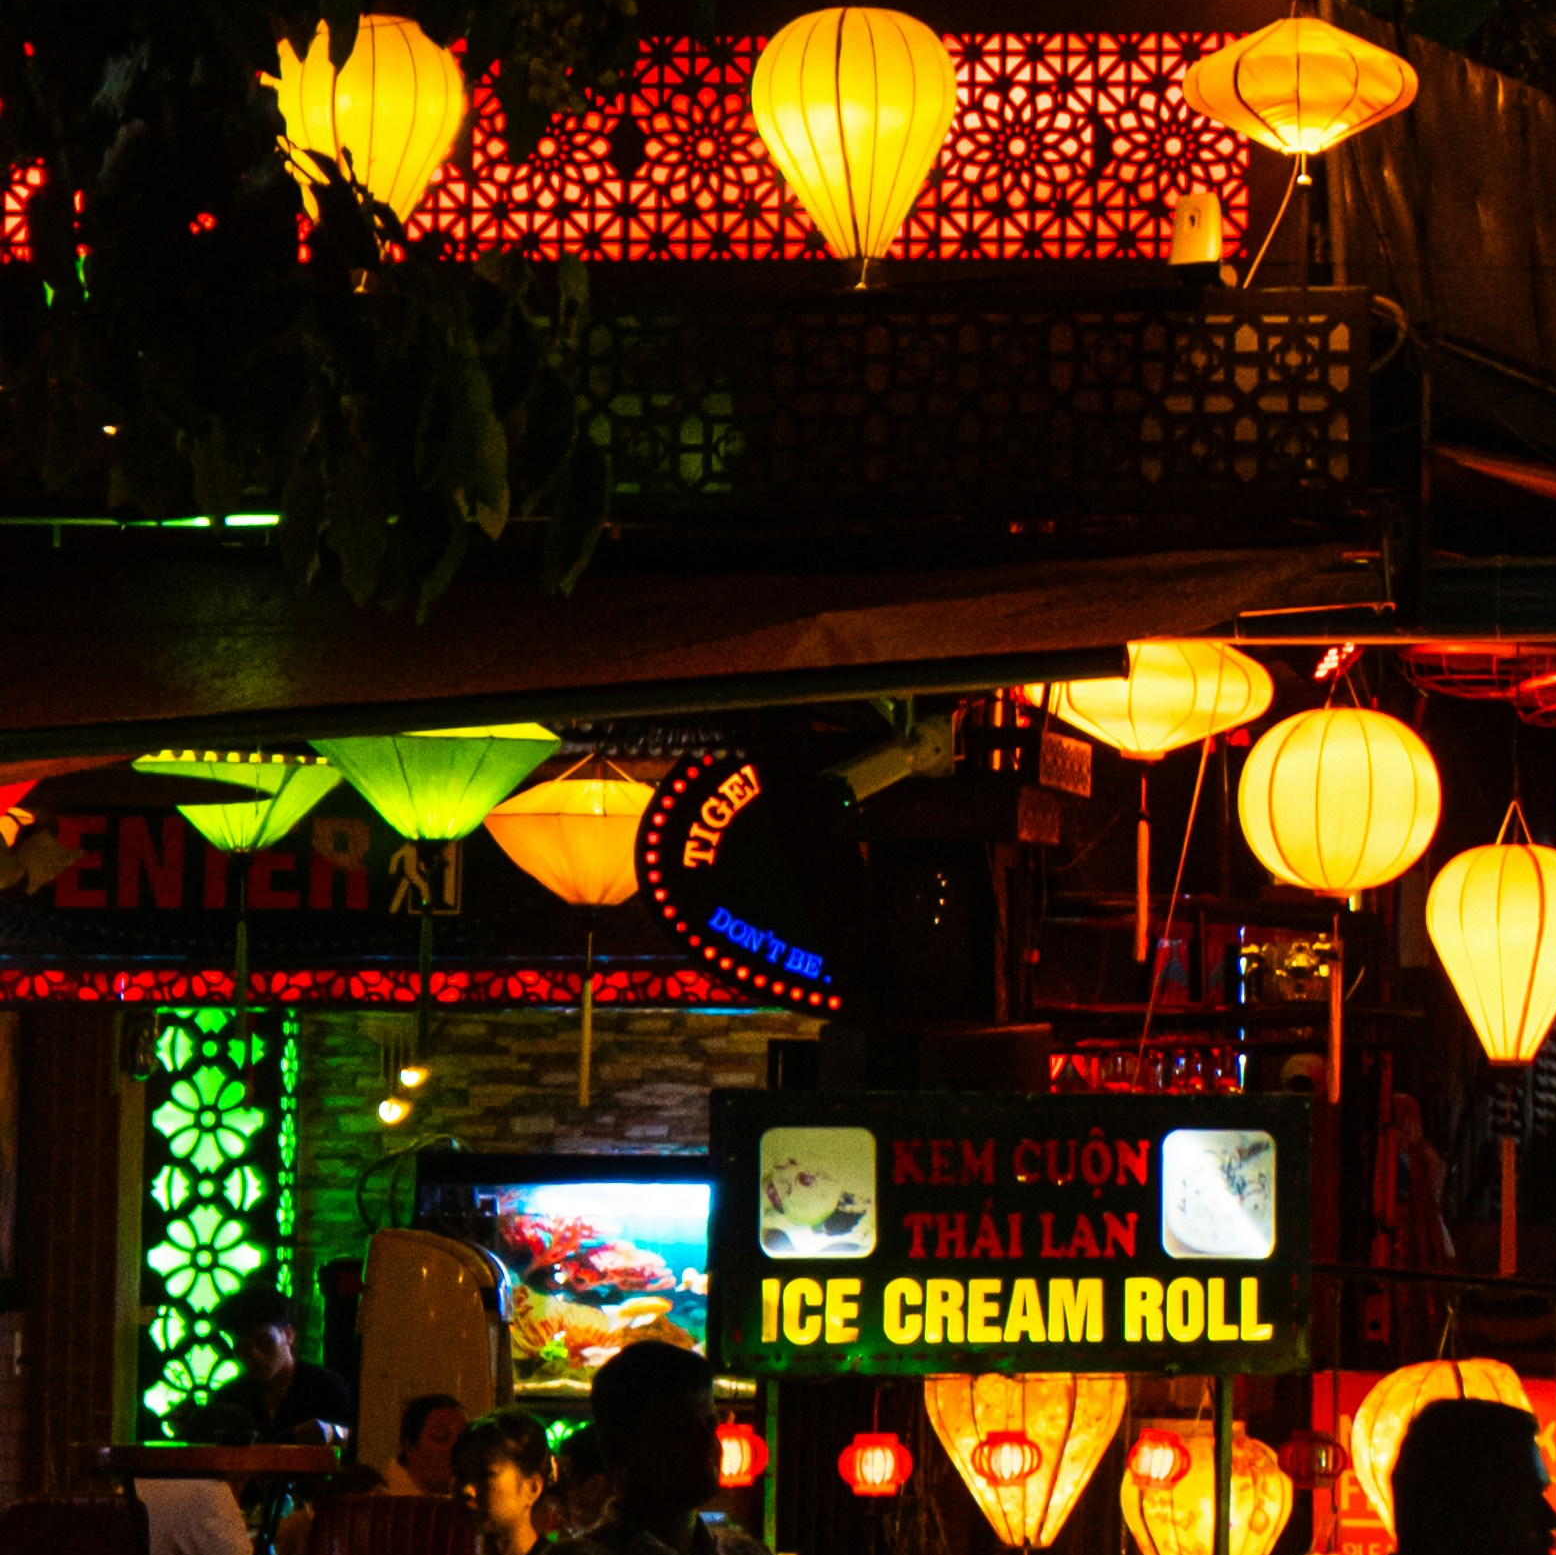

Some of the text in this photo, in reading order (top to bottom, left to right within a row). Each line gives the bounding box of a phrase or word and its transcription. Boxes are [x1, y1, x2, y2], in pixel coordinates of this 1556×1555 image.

[708, 906, 823, 978] DON'T BE
[892, 1139, 997, 1187] KEM
[903, 1198, 1140, 1259] THÁI LAN
[761, 1276, 1273, 1345] ICE CREAM ROLL
